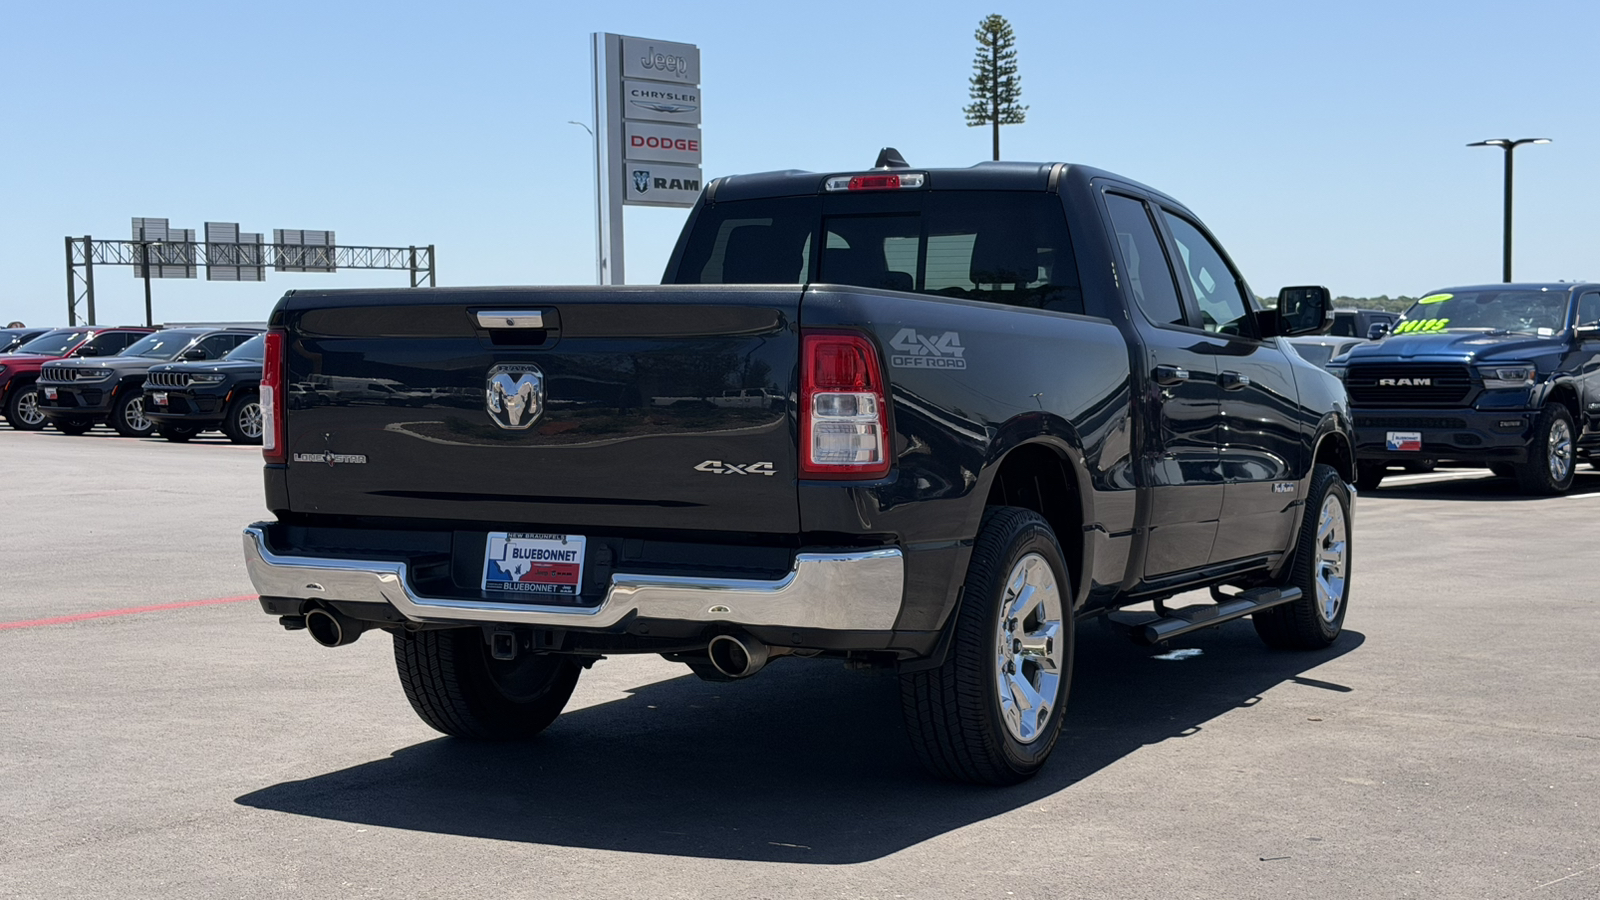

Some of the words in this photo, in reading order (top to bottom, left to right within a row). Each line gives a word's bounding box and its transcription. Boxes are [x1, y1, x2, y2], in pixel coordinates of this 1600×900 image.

[641, 47, 687, 78] Jeep
[631, 89, 696, 102] CHRYSLER
[631, 135, 699, 151] DODGE
[654, 177, 699, 191] RAM
[893, 357, 922, 366] OFF
[926, 358, 965, 368] ROAD
[1379, 378, 1431, 386] RAM
[294, 453, 325, 462] LONE
[333, 454, 367, 463] STAR
[512, 548, 577, 562] BLUEBONNET
[503, 582, 558, 593] BLUEBONNET
